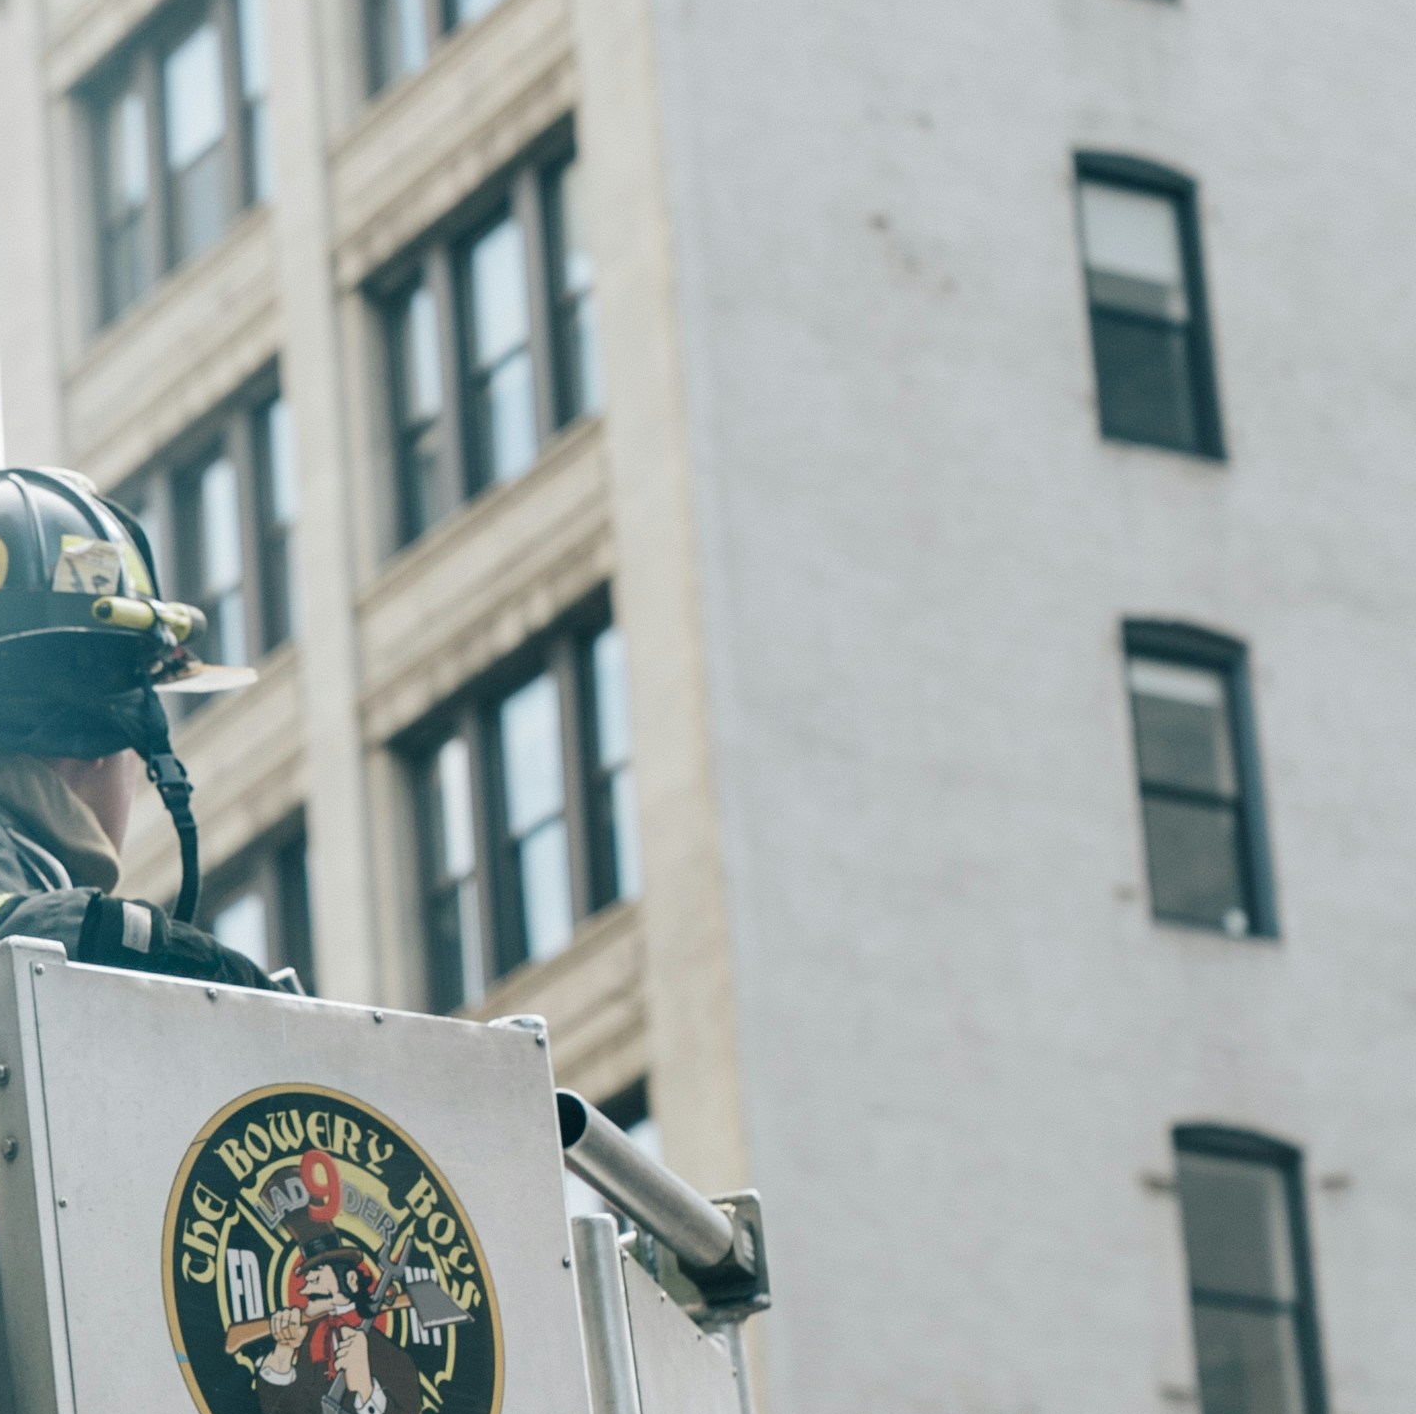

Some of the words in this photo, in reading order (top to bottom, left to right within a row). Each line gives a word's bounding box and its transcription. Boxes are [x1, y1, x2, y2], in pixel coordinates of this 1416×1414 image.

[213, 1109, 394, 1182] BOWERY
[405, 1171, 482, 1311] BOYS
[300, 1149, 341, 1222] 9
[227, 1248, 265, 1323] FD
